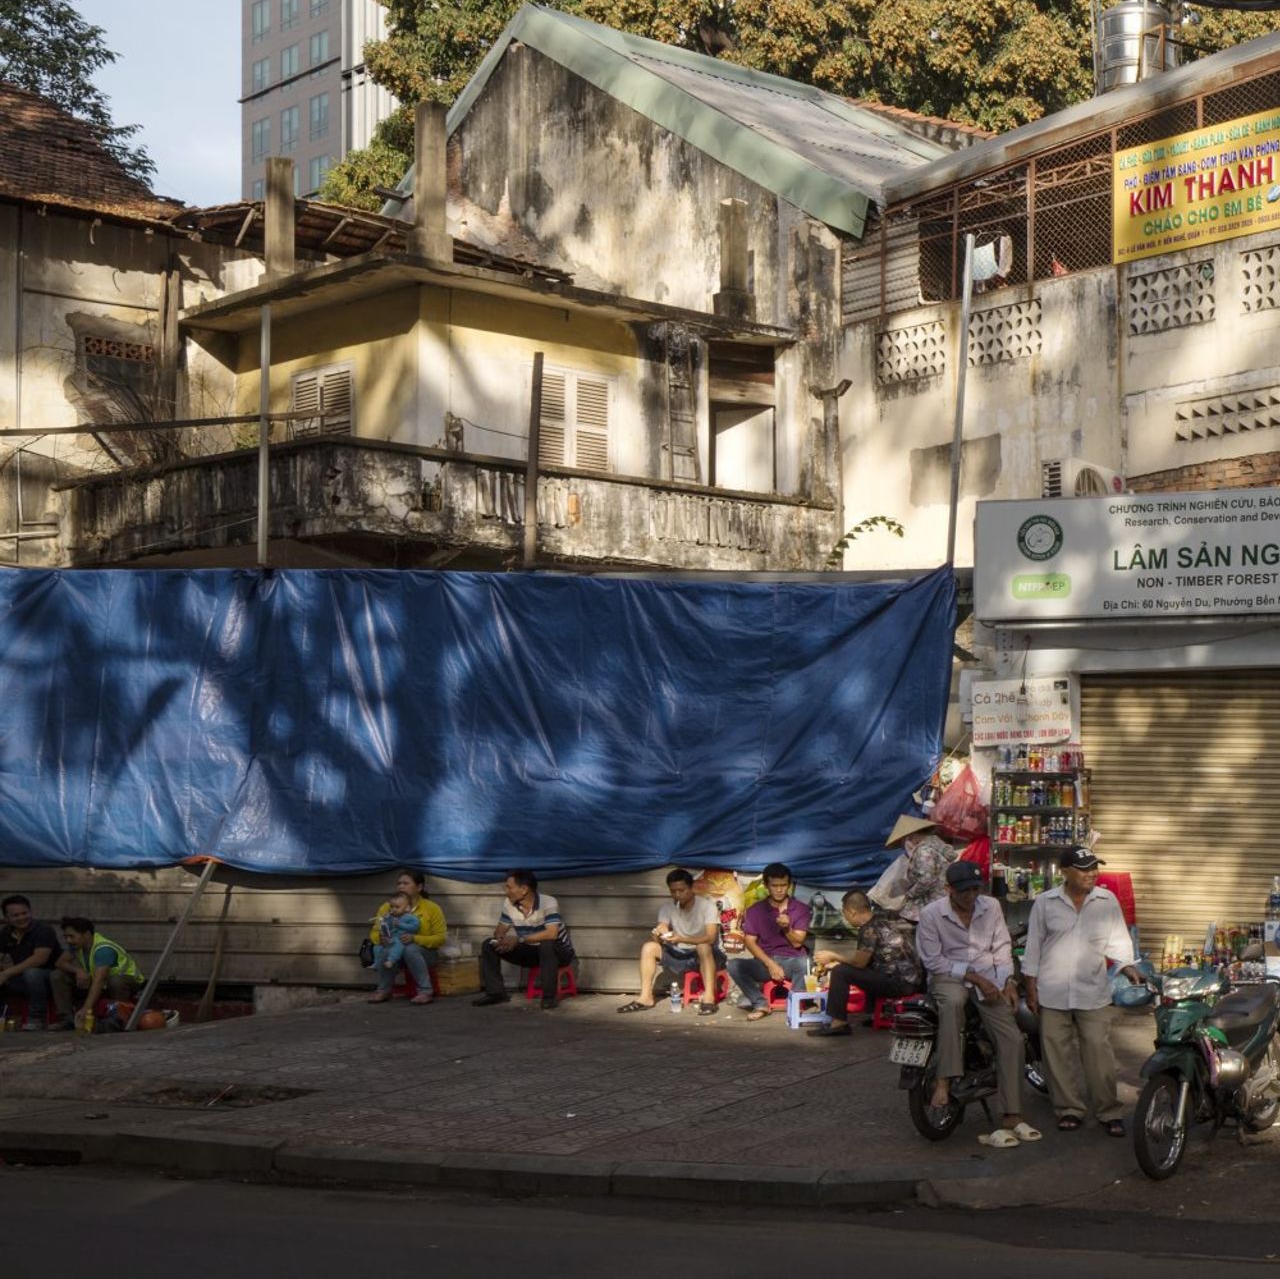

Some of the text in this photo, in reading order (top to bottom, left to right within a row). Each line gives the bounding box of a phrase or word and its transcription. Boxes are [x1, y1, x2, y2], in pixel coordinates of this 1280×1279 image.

[1129, 155, 1275, 218] KIM THANH
[1143, 209, 1183, 237] CHÁO
[1187, 204, 1220, 226] CHO
[1224, 198, 1242, 217] EM
[1109, 503, 1154, 515] CHƯƠNG
[1157, 500, 1187, 512] TRÌNH
[1189, 498, 1228, 511] NGHIÊN
[1174, 513, 1238, 526] Conservation
[1240, 512, 1259, 522] and
[1113, 543, 1168, 571] LÂM
[1177, 540, 1232, 570] SẢN
[1137, 577, 1164, 589] NON
[1176, 574, 1223, 588] TIMBER
[1227, 573, 1279, 586] FOREST
[1103, 599, 1119, 612] Địa
[1142, 599, 1154, 609] 60
[1156, 596, 1192, 612] Nguyễn
[1195, 597, 1211, 609] Du,
